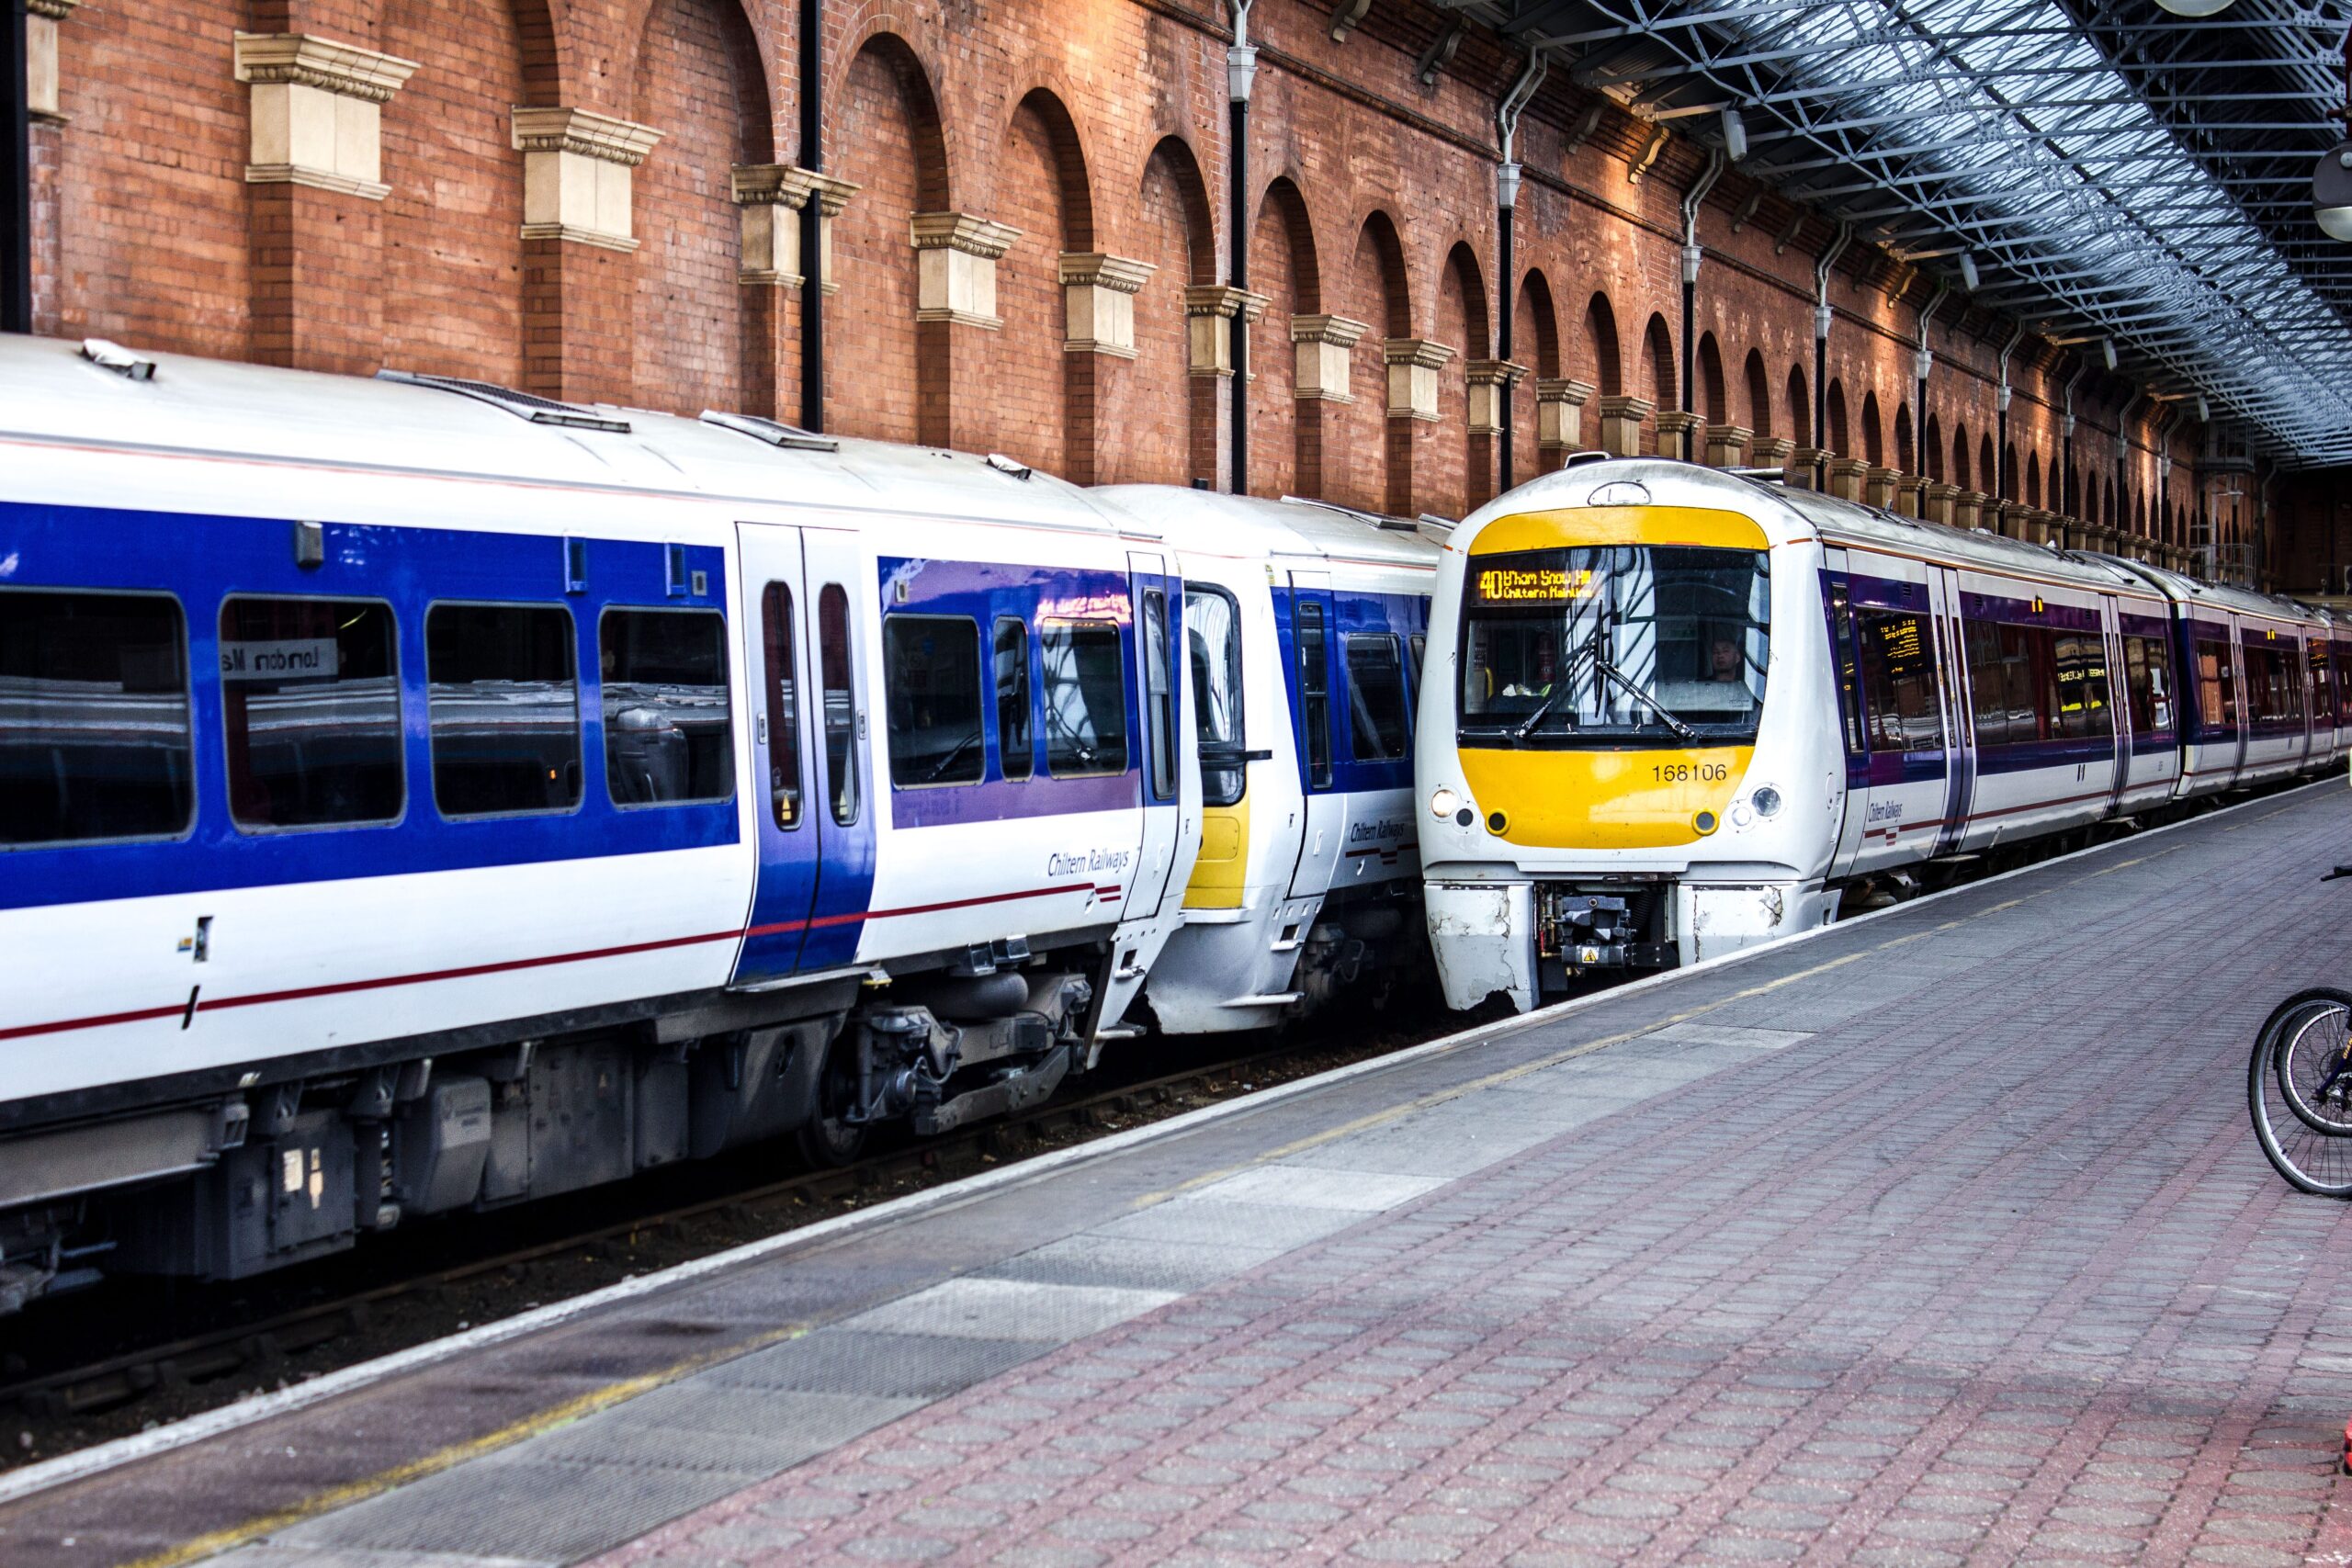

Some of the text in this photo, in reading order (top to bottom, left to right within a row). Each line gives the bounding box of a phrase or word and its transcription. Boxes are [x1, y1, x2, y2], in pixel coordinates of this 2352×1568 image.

[1480, 570, 1502, 599] 40
[1541, 570, 1571, 586] Snow
[1653, 764, 1727, 782] 168106
[1351, 818, 1405, 842] Chiltern Railways
[1048, 848, 1129, 876] Chiltern Railways
